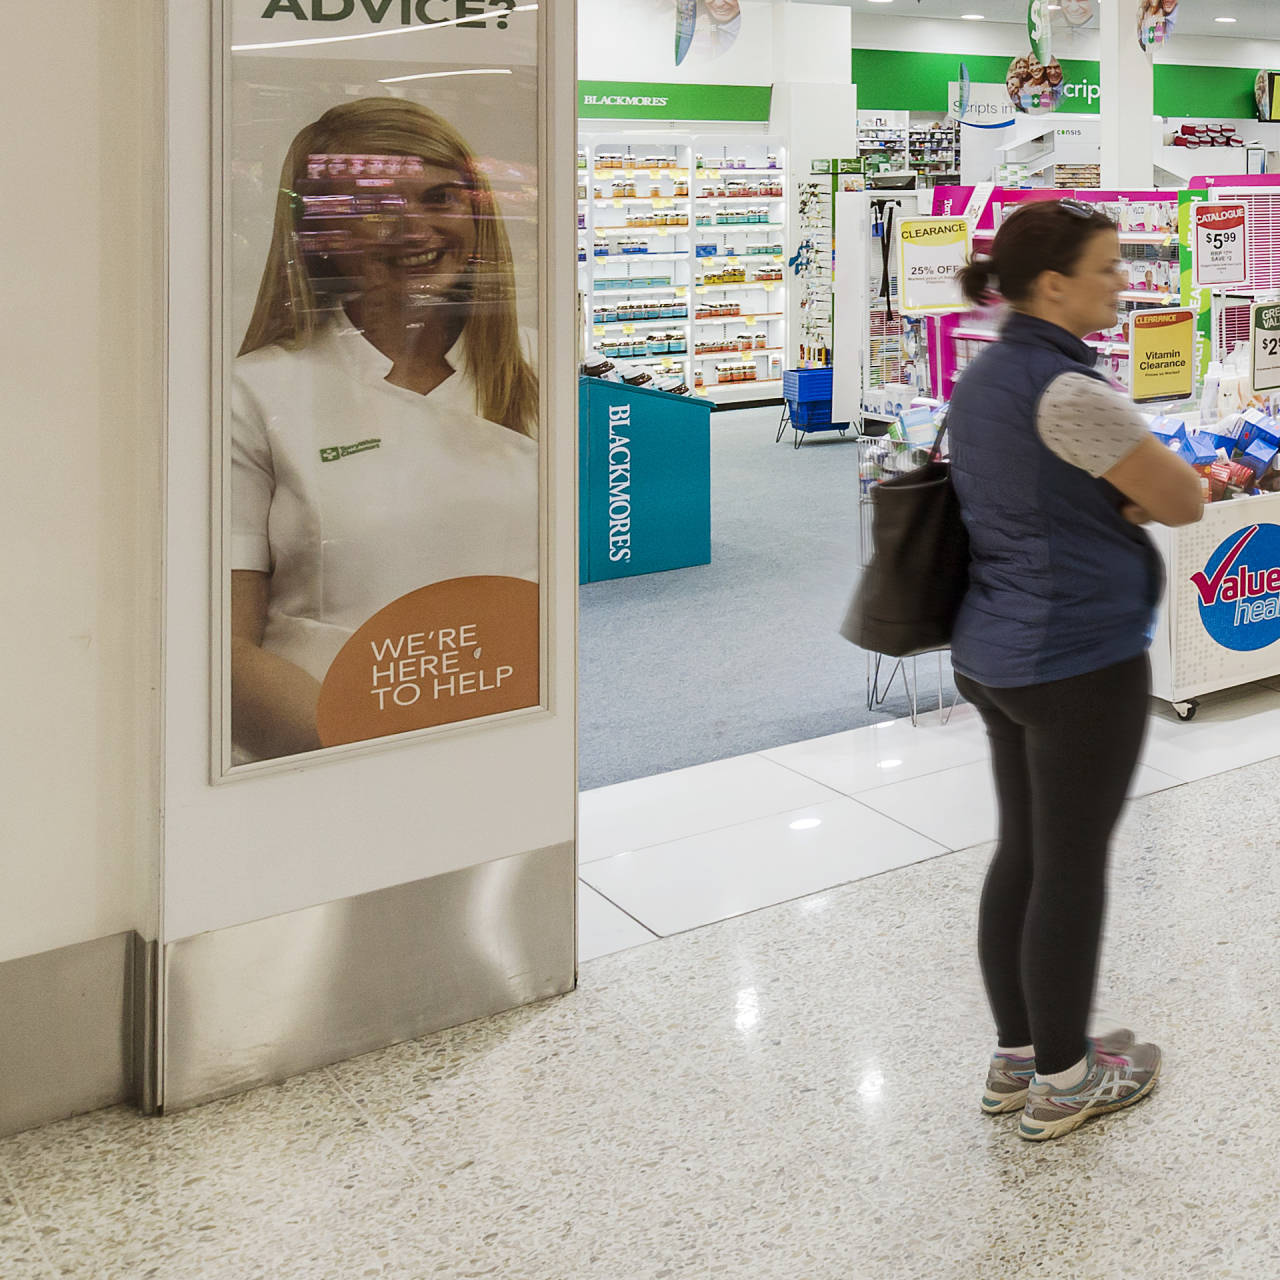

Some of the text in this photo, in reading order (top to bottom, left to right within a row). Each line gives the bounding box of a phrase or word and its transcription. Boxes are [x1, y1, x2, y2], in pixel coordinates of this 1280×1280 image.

[1060, 79, 1100, 104] crip
[583, 95, 669, 107] BLACKMORES
[1195, 208, 1245, 224] CATALOGUE
[901, 222, 966, 240] CLEARANCE
[911, 266, 934, 275] 25%
[1135, 314, 1177, 324] CLEARANCE
[1145, 350, 1180, 360] Vitamin
[1139, 360, 1186, 371] Clearance
[607, 404, 630, 563] BLACKMORES
[370, 623, 478, 662] WE’RE
[371, 651, 461, 687] HERE
[371, 664, 514, 711] TO HELP
